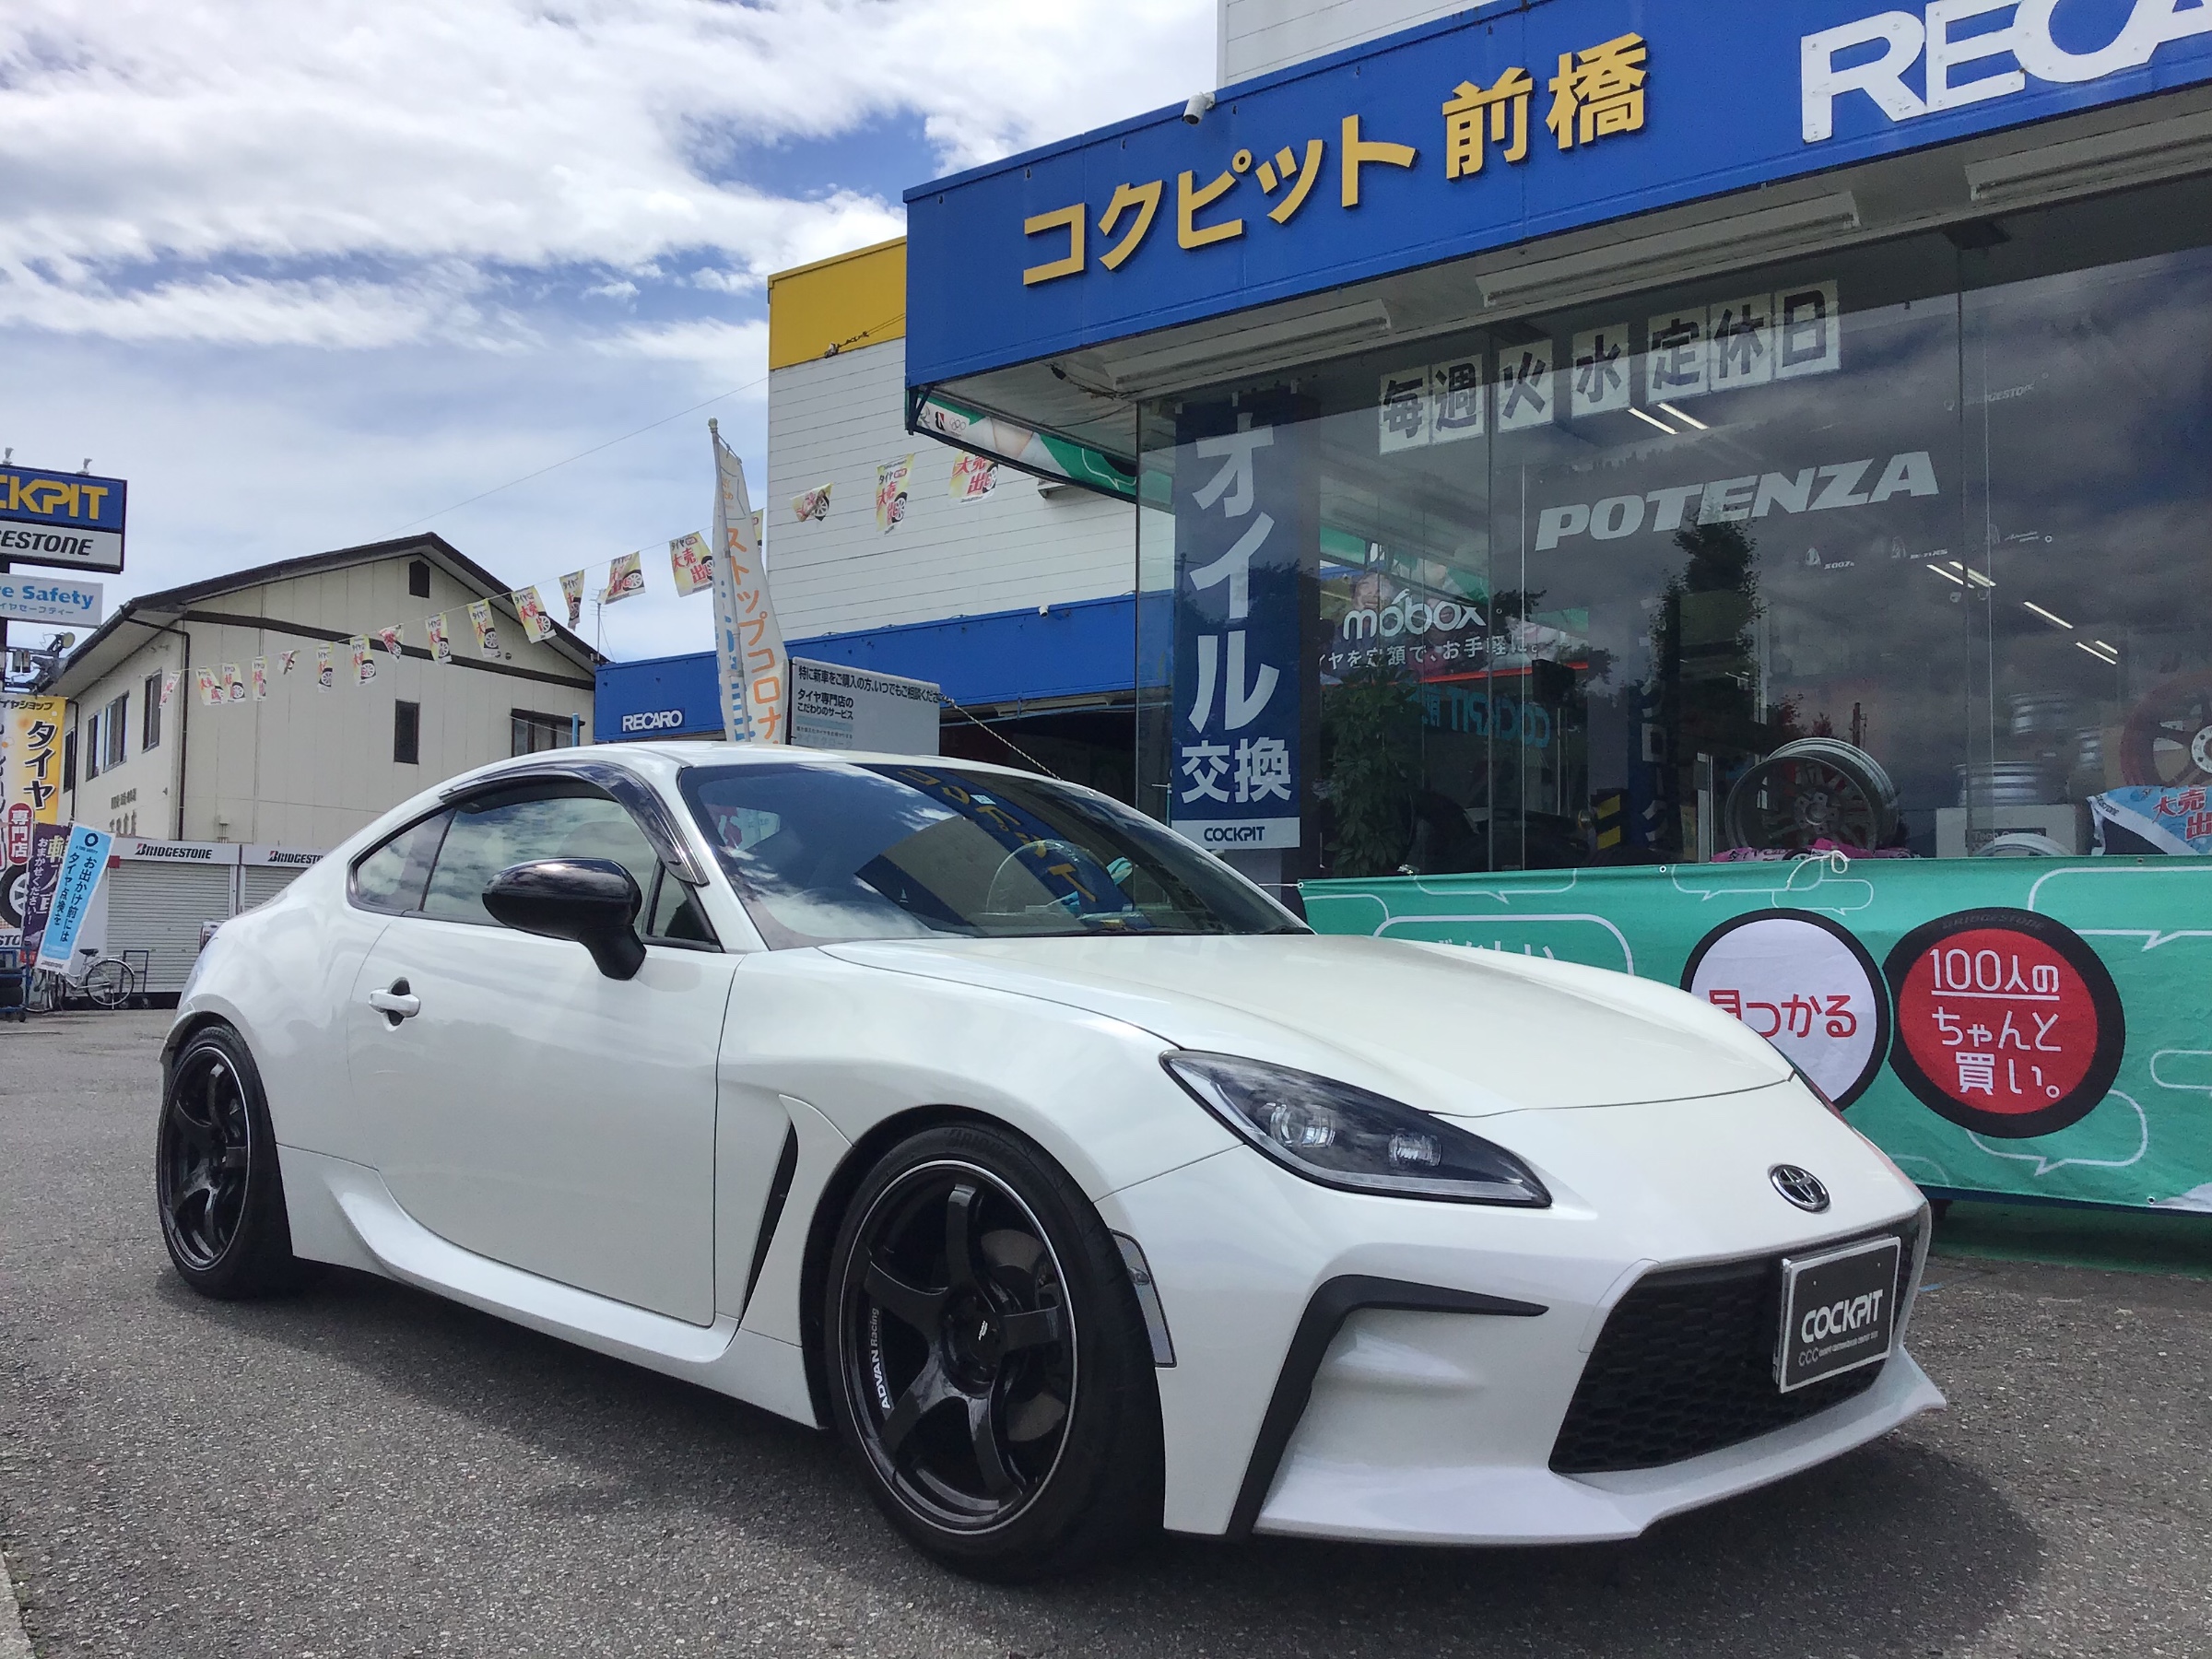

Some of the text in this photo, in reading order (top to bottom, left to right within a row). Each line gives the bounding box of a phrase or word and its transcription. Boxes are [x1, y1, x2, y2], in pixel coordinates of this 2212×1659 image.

[1023, 31, 1646, 286] コクピット 前橋
[0, 475, 109, 520] KPIT
[1535, 451, 1939, 551] POTENZA
[0, 529, 94, 557] ESTONE
[1189, 412, 1279, 733] オイル
[0, 585, 95, 609] e Safety
[797, 688, 854, 709] タイヤ専門店の
[798, 665, 941, 704] 特に新車をご購入の方、いつでもご相談くださ
[622, 710, 683, 732] RECARO
[797, 701, 854, 721] こだわりのサービス
[24, 721, 55, 809] タイヤ
[1181, 736, 1292, 804] 交換
[11, 810, 29, 858] 専門店
[135, 843, 213, 859] BRIDGESTONE
[1204, 826, 1265, 842] COCKPIT
[60, 856, 98, 942] お出かけ前には
[1930, 947, 2061, 994] 100人の
[1931, 1006, 2062, 1053] ちゃんと
[1955, 1051, 2061, 1099] 買い。
[1801, 1289, 1883, 1344] COCKPIT
[870, 1307, 891, 1409] ADVAN Racing
